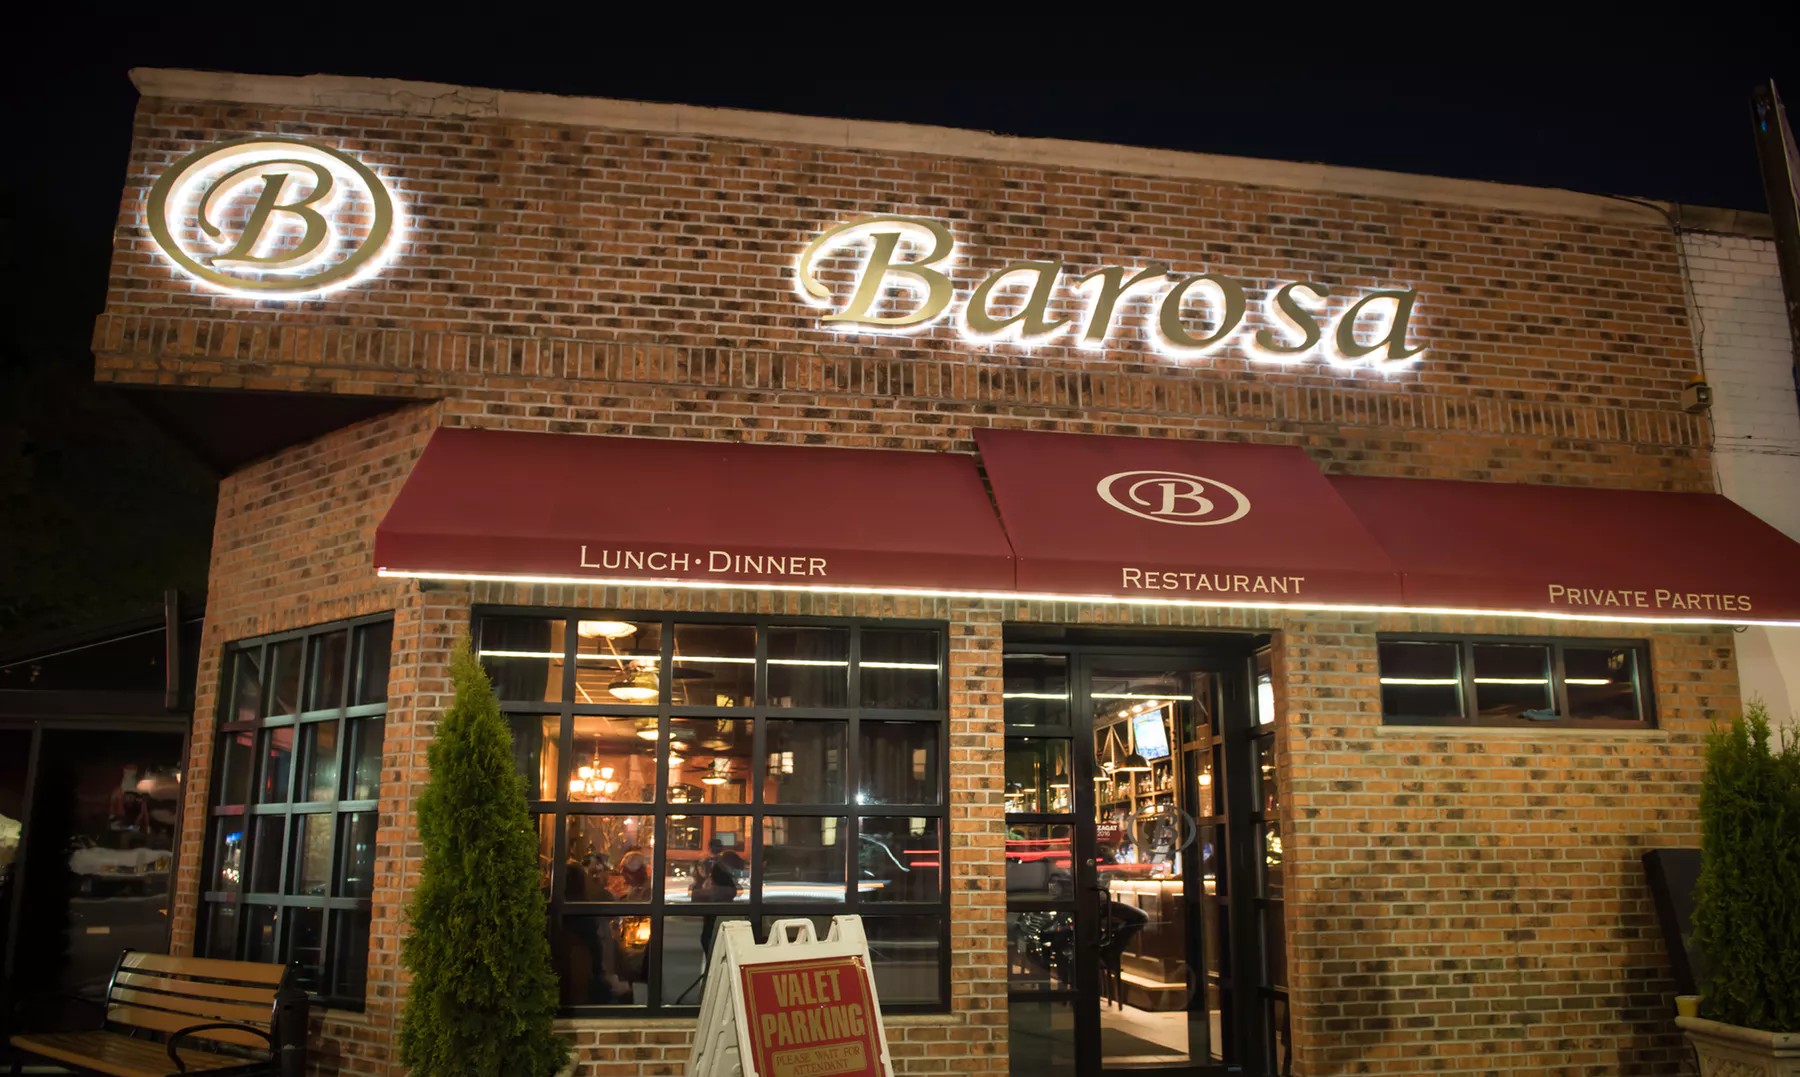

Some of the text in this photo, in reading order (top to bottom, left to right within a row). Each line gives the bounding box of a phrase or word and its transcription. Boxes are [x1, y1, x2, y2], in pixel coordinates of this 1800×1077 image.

[197, 158, 334, 265] B
[799, 215, 1430, 361] Barosa
[1128, 478, 1215, 517] B
[1121, 567, 1306, 595] RESTAURANT
[1548, 584, 1752, 612] PRIVATE PARTIES
[1096, 824, 1118, 832] ZAGAT
[772, 969, 841, 1007] VALET
[761, 1003, 865, 1048] PARKING
[776, 1045, 860, 1066] PLEASE WAIT FOR
[793, 1058, 849, 1076] ATTENDANT
